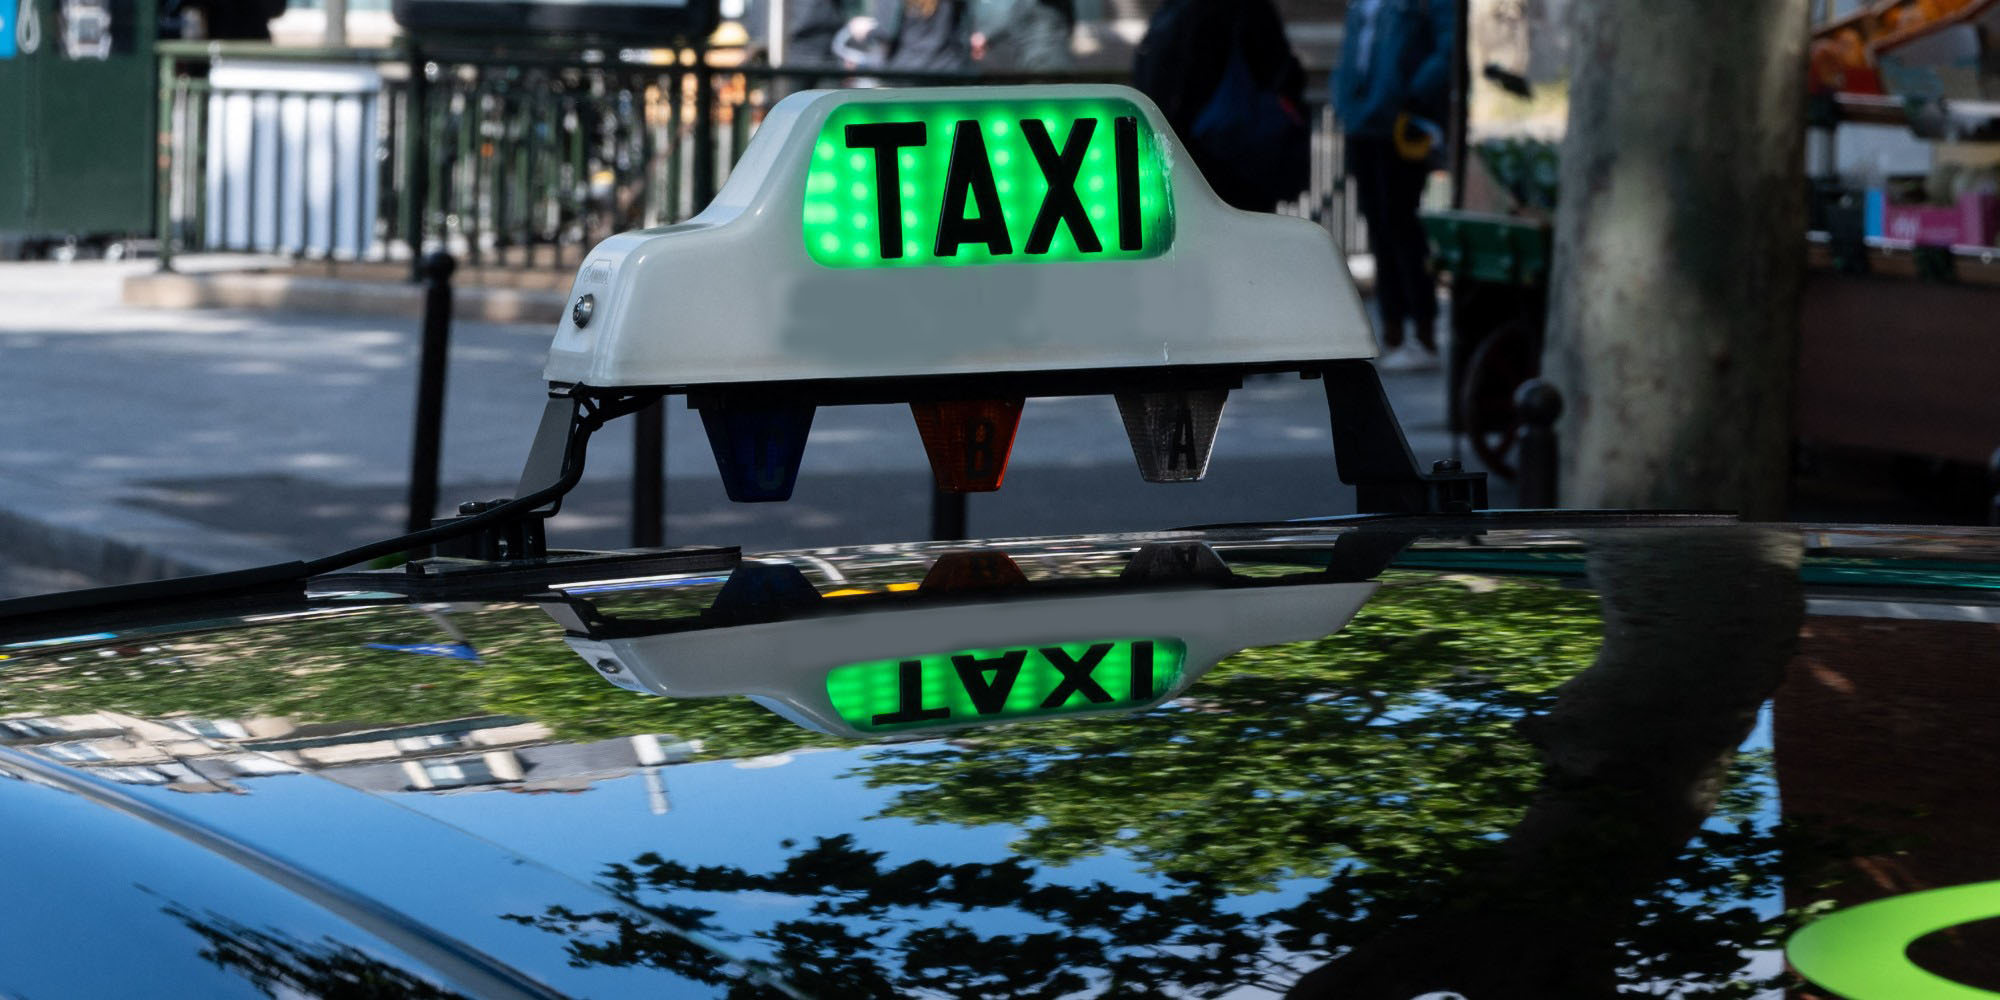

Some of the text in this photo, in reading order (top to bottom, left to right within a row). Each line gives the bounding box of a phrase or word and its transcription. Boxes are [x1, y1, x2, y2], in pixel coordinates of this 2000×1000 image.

[845, 117, 1142, 259] TAXI
[966, 419, 993, 478] B
[1168, 403, 1197, 470] A
